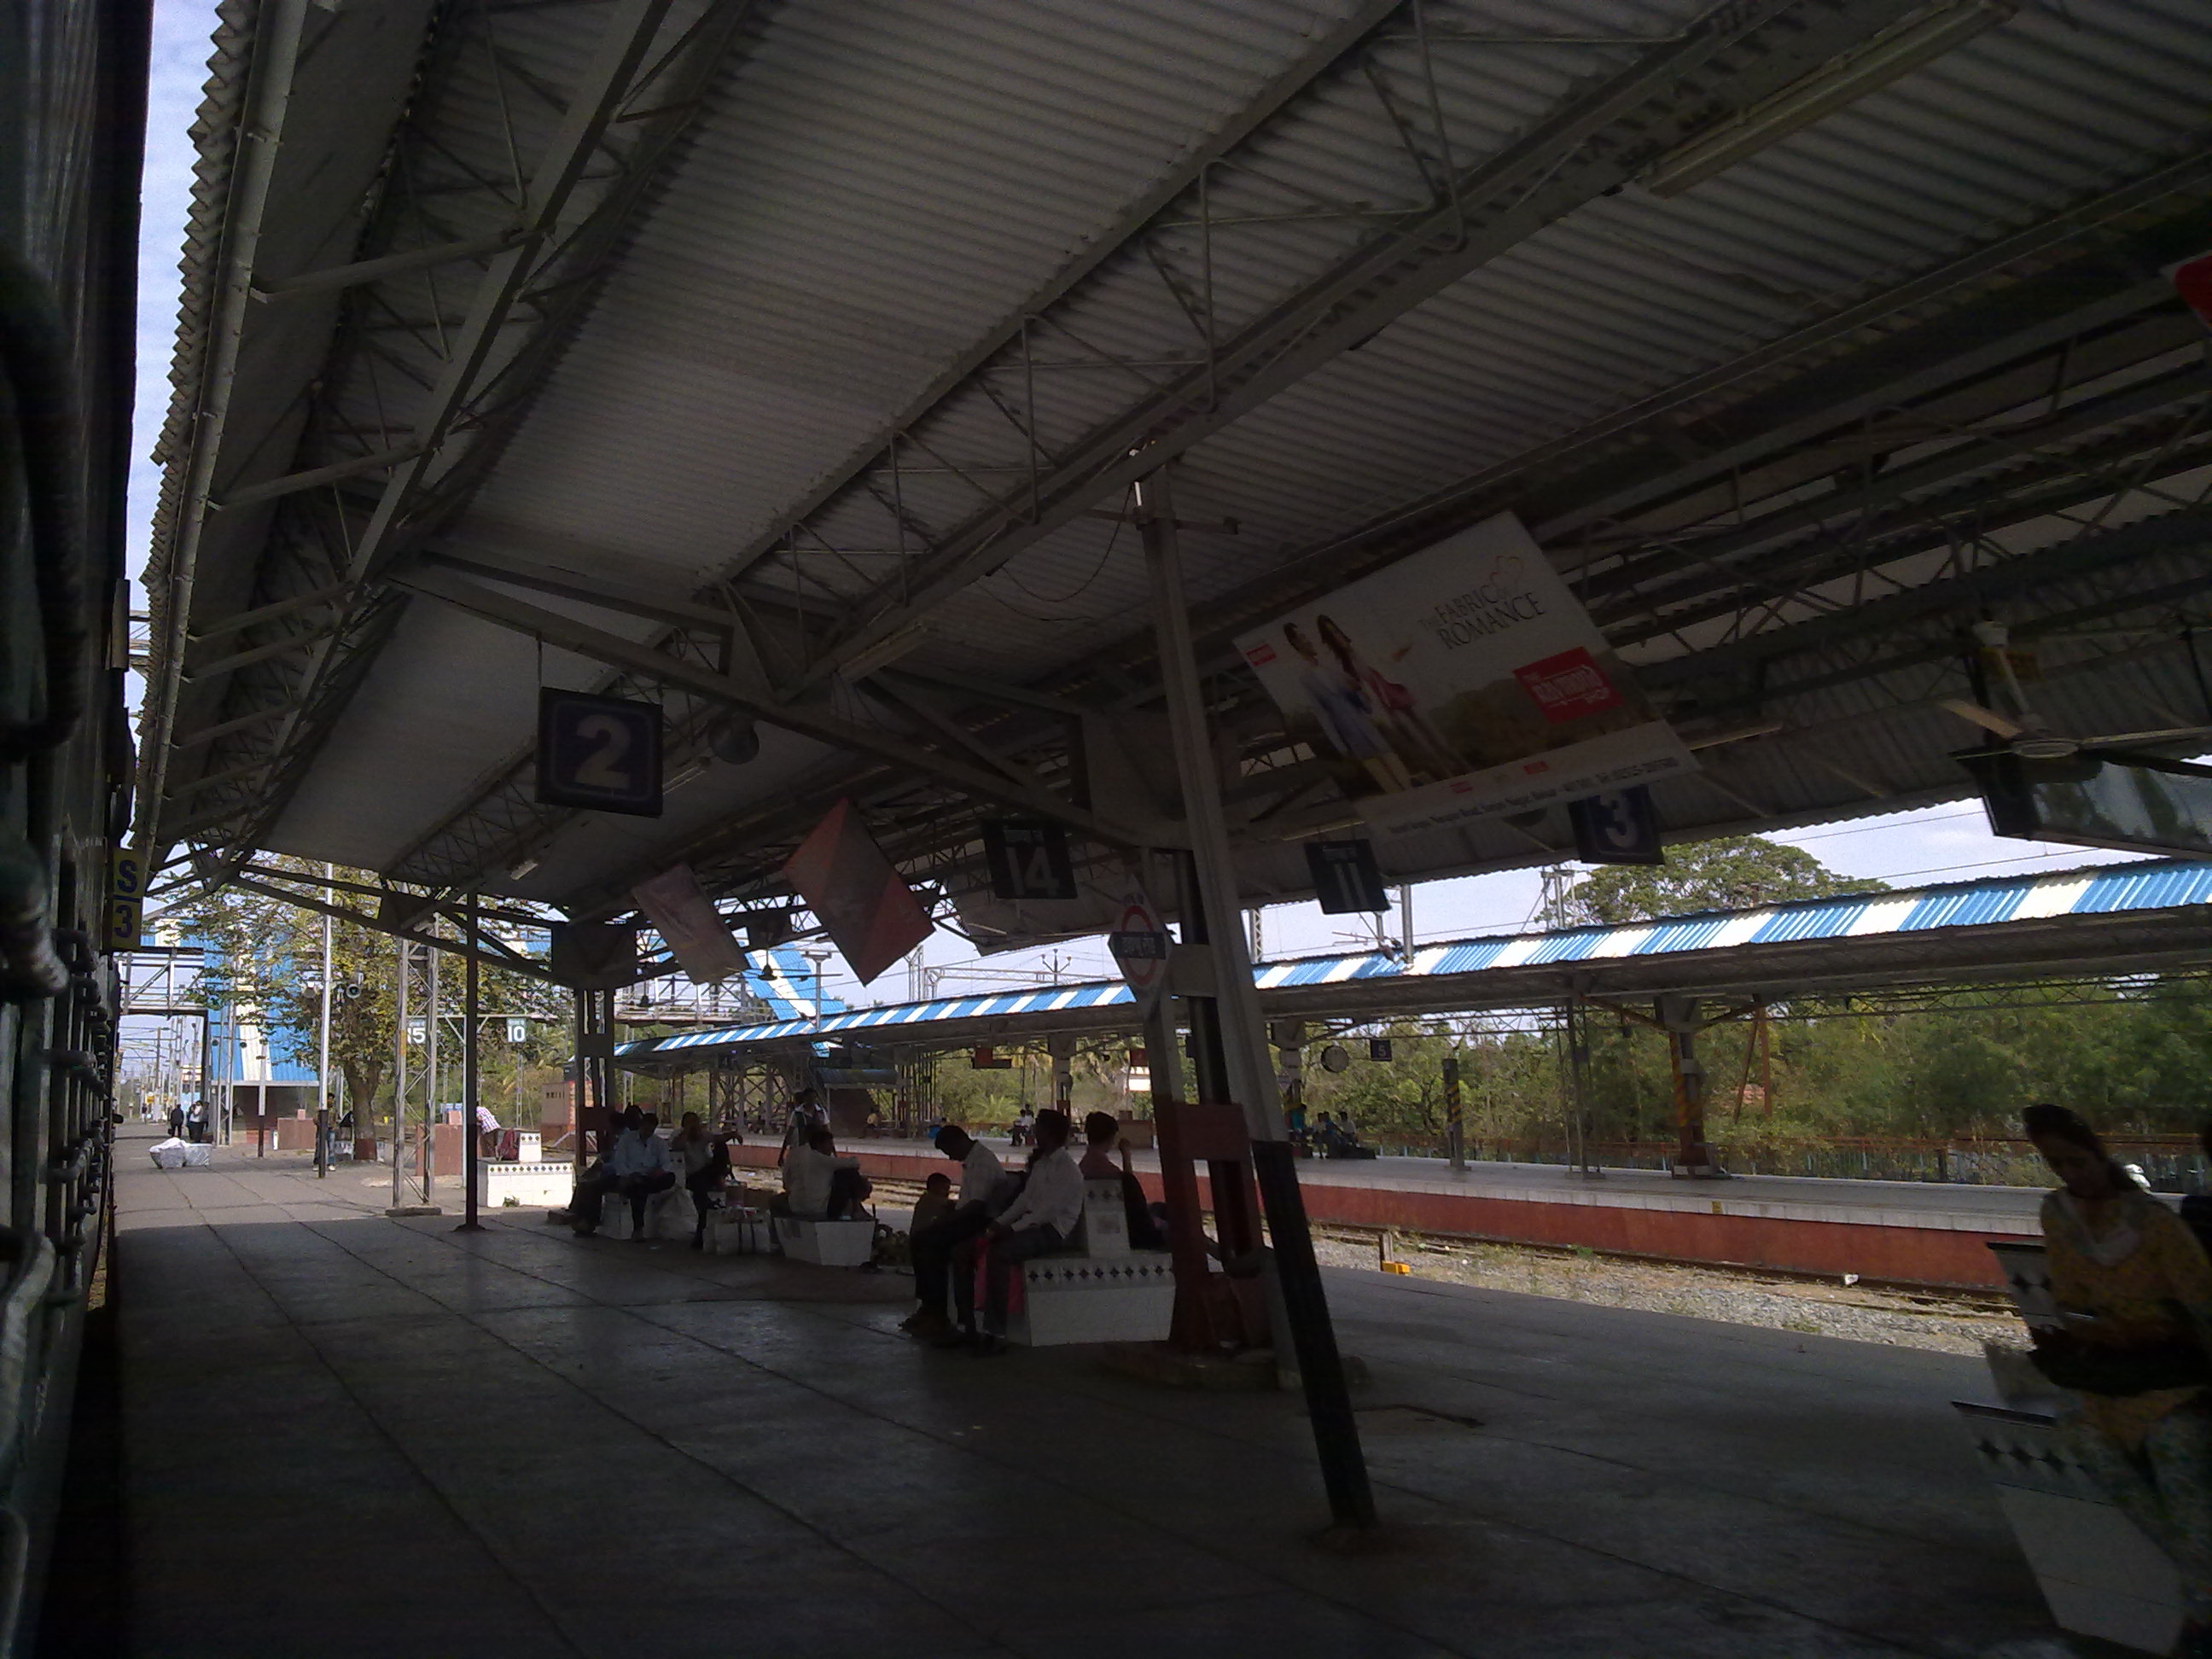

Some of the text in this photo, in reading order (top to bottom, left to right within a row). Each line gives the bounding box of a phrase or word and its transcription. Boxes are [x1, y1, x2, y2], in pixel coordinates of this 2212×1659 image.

[1434, 585, 1498, 624] FABRIC
[1436, 592, 1545, 649] ROMANCE
[573, 714, 631, 790] 2
[1599, 790, 1639, 847] 3
[118, 859, 137, 894] S
[1005, 846, 1059, 896] 14
[1334, 862, 1371, 910] 11
[114, 905, 133, 938] 3
[406, 1026, 426, 1044] 15
[507, 1025, 526, 1043] 10
[1378, 1044, 1387, 1057] 5
